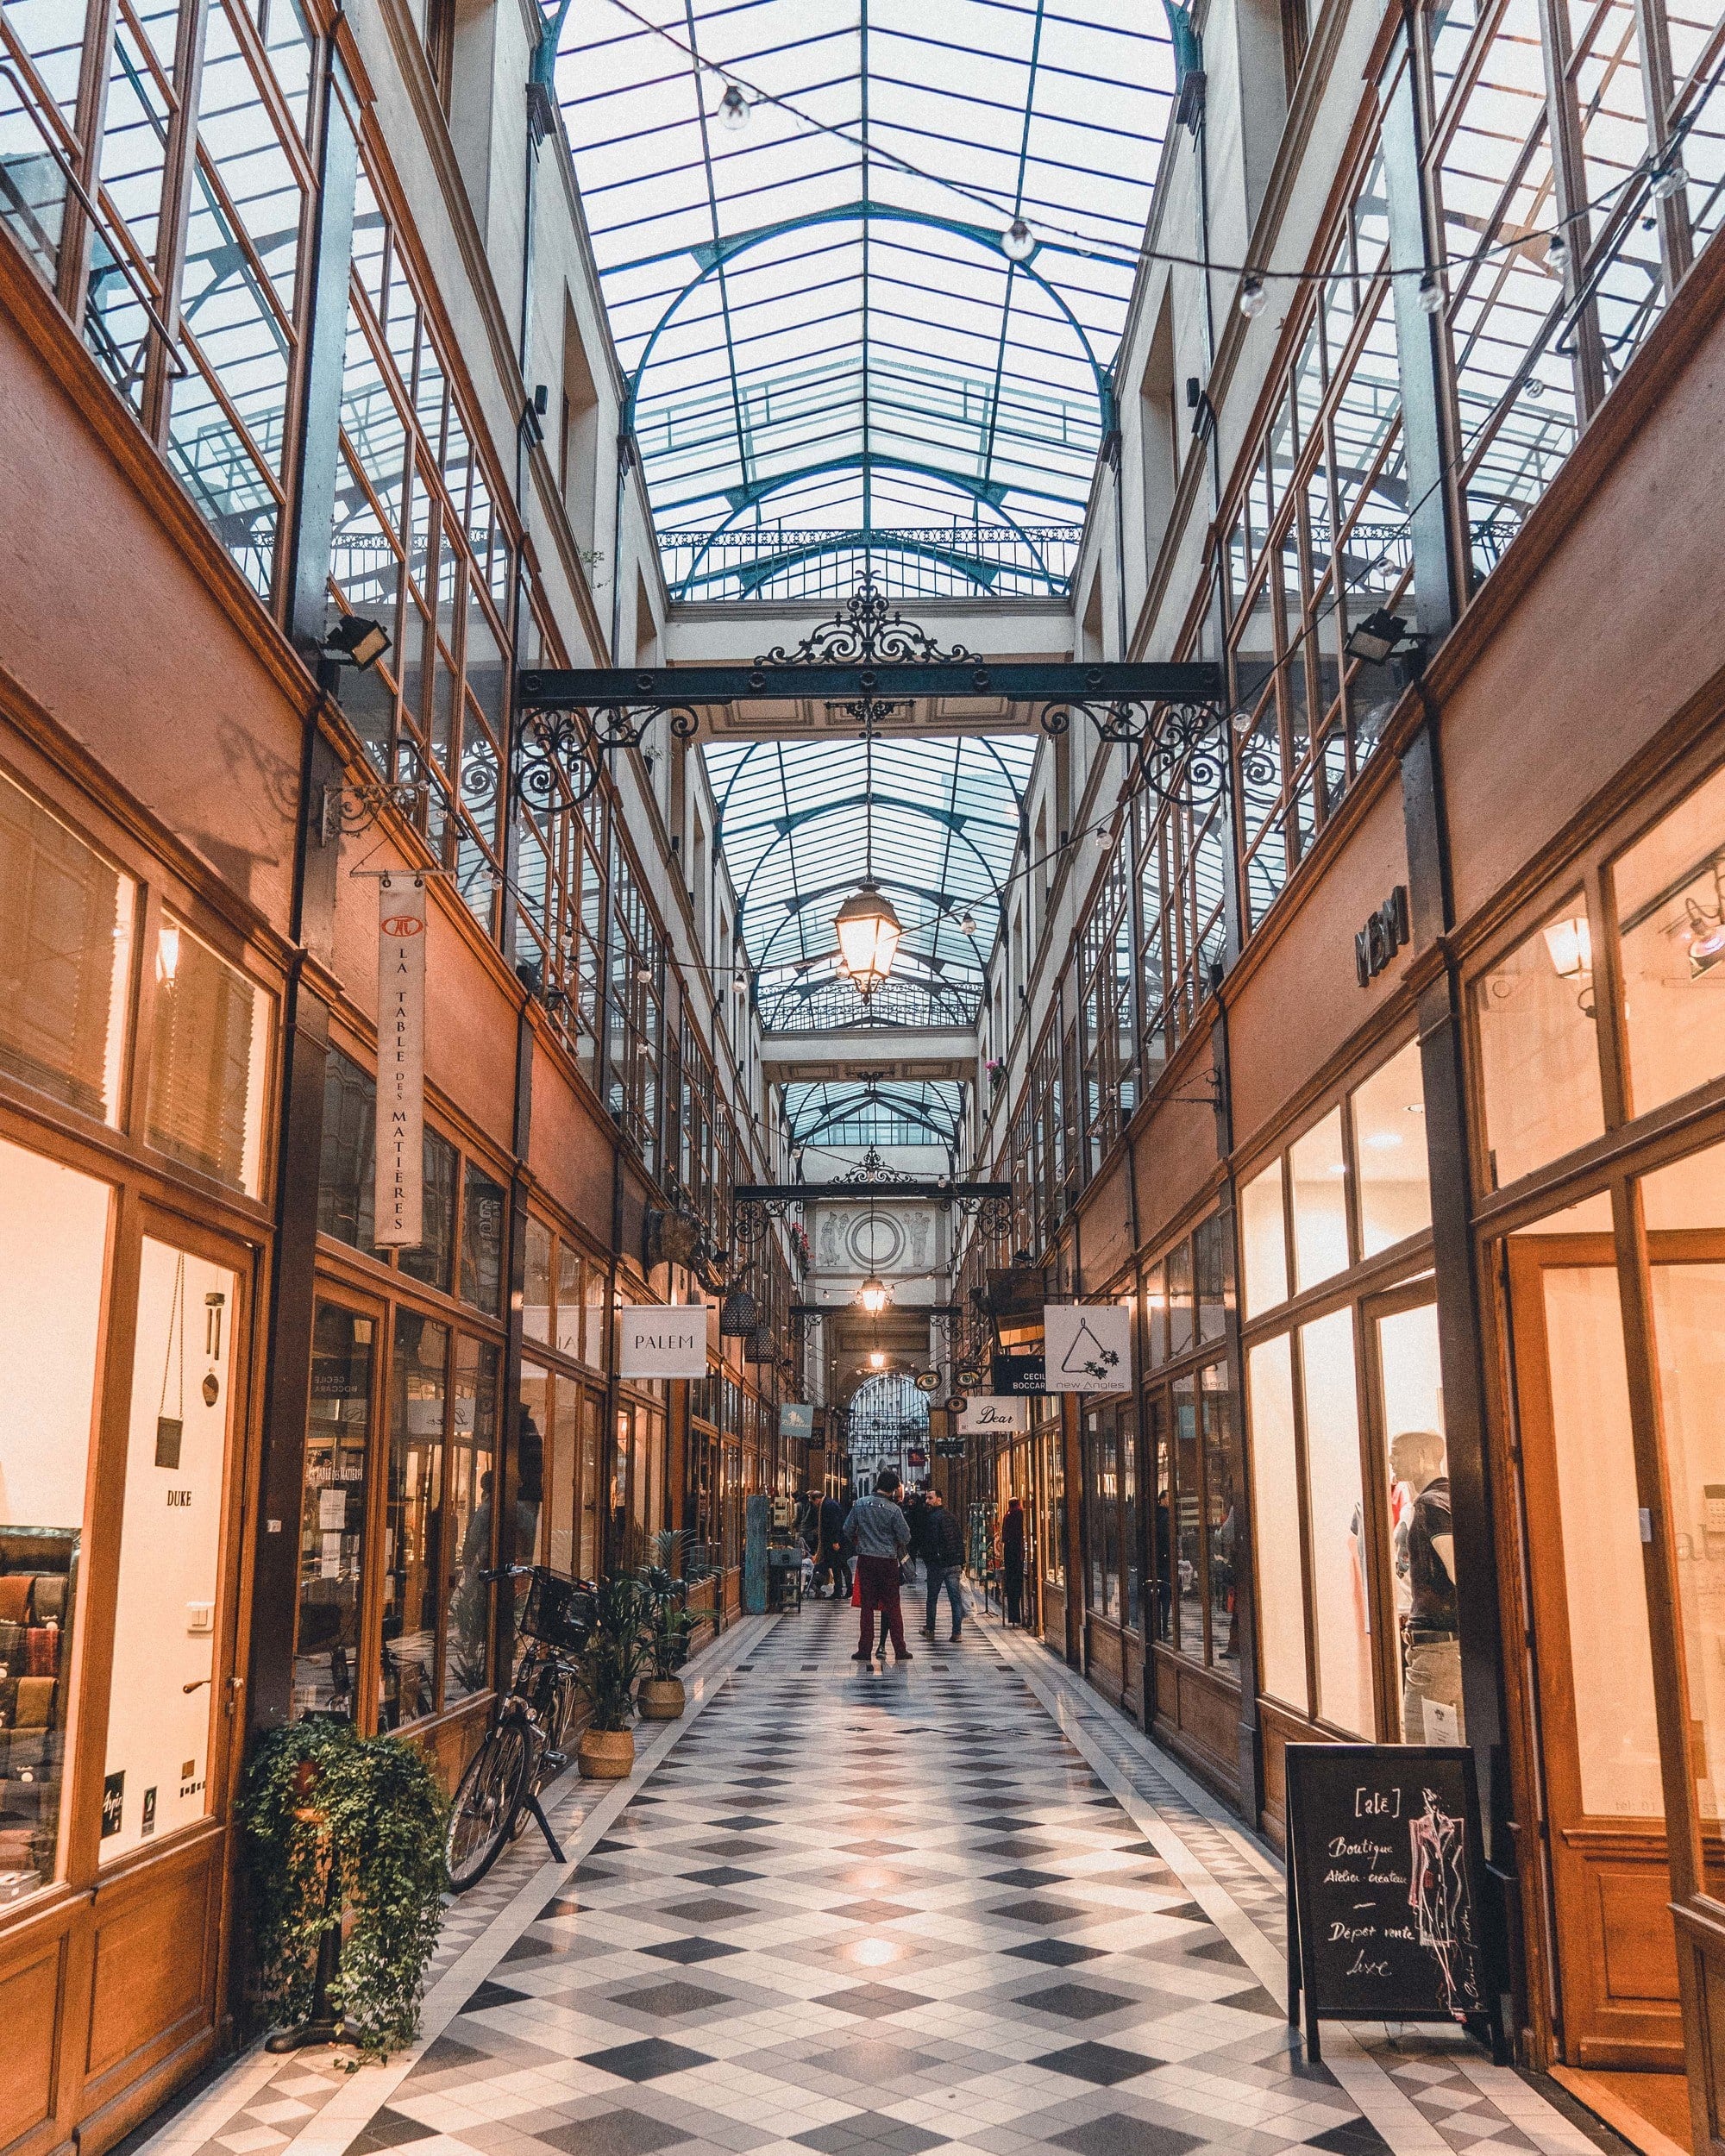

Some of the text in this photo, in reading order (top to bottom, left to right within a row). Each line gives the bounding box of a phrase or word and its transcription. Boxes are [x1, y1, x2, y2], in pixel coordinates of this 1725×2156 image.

[391, 947, 408, 1231] LA TABLE DES MATIÈRES
[635, 1335, 694, 1350] PALEM
[1023, 1372, 1046, 1382] CECIL
[1013, 1382, 1046, 1390] BOCCAR
[976, 1405, 1013, 1426] Dear
[167, 1490, 191, 1507] DUKE
[1328, 1836, 1393, 1870] Boutique
